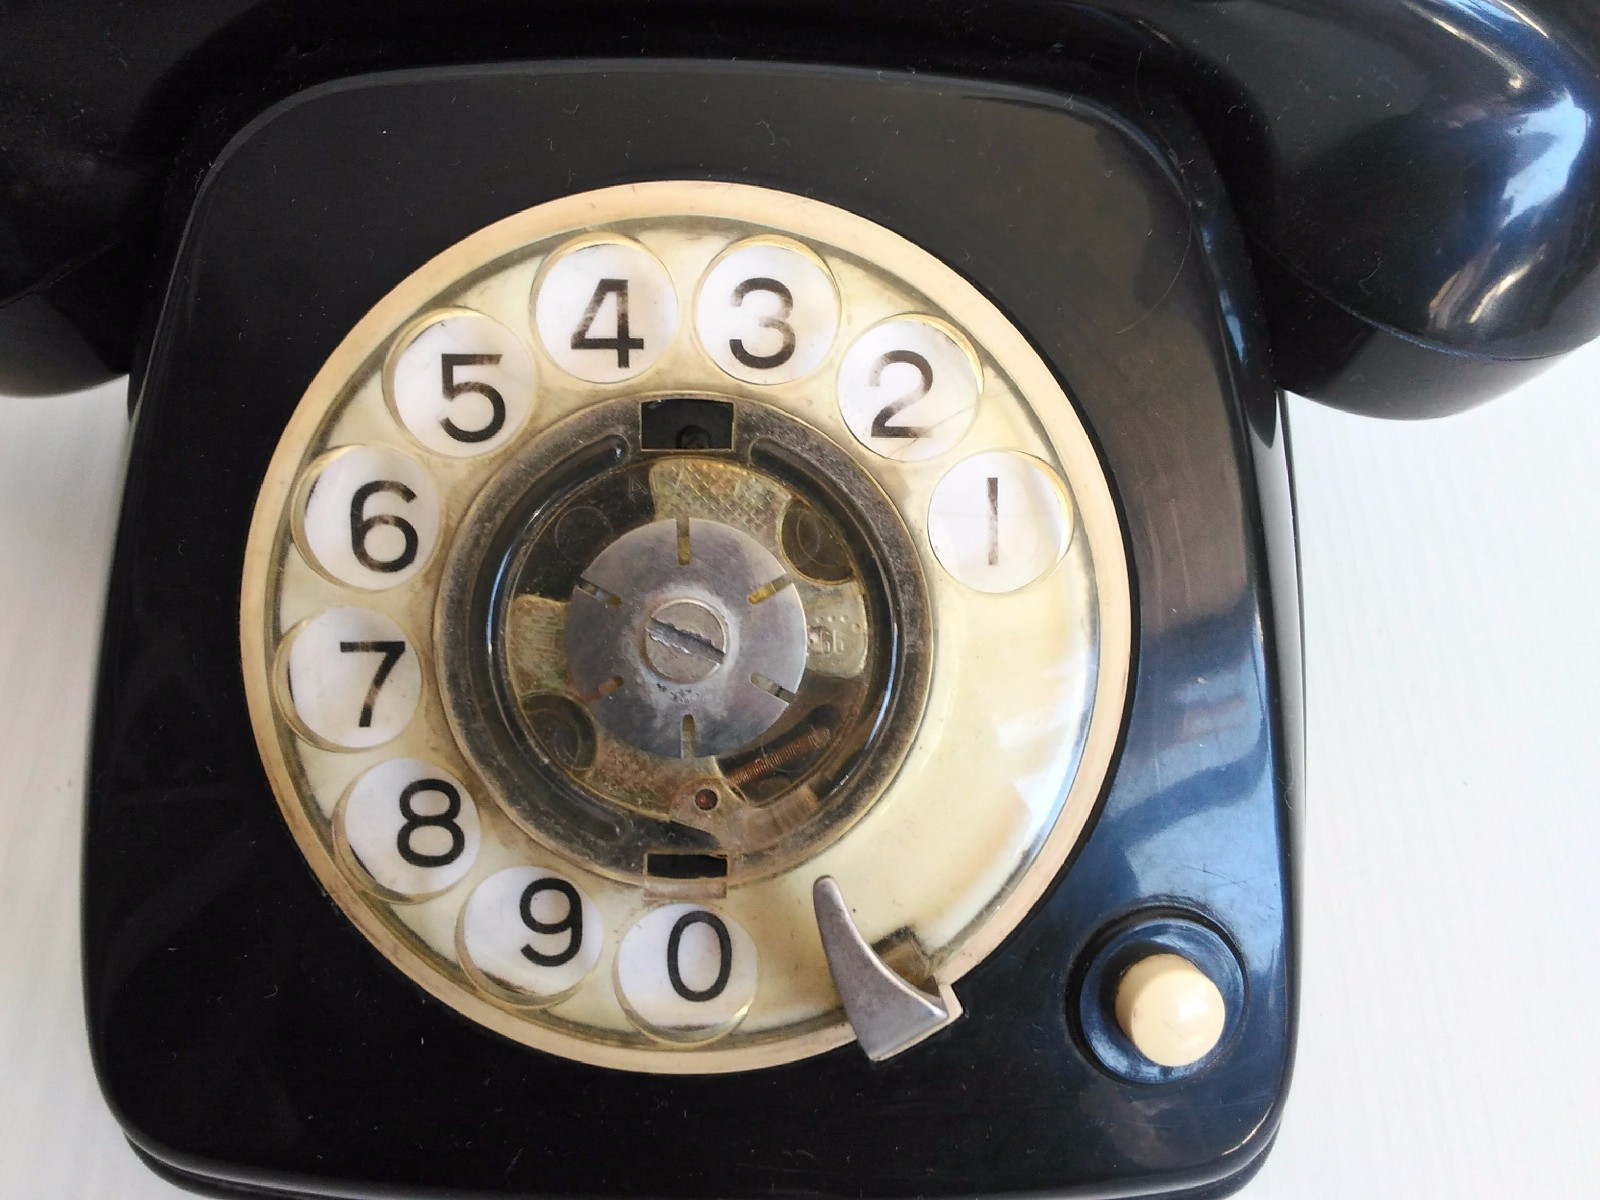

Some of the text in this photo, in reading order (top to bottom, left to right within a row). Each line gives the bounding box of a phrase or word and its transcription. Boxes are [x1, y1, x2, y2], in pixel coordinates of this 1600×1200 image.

[572, 279, 643, 368] 4
[730, 277, 795, 368] 3
[441, 353, 505, 442] 5
[872, 350, 934, 438] 2
[350, 480, 417, 572] 6
[985, 477, 1000, 565] 1
[340, 640, 406, 727] 7
[398, 778, 465, 867] 8
[520, 878, 583, 967] 9
[667, 910, 732, 1001] 0
